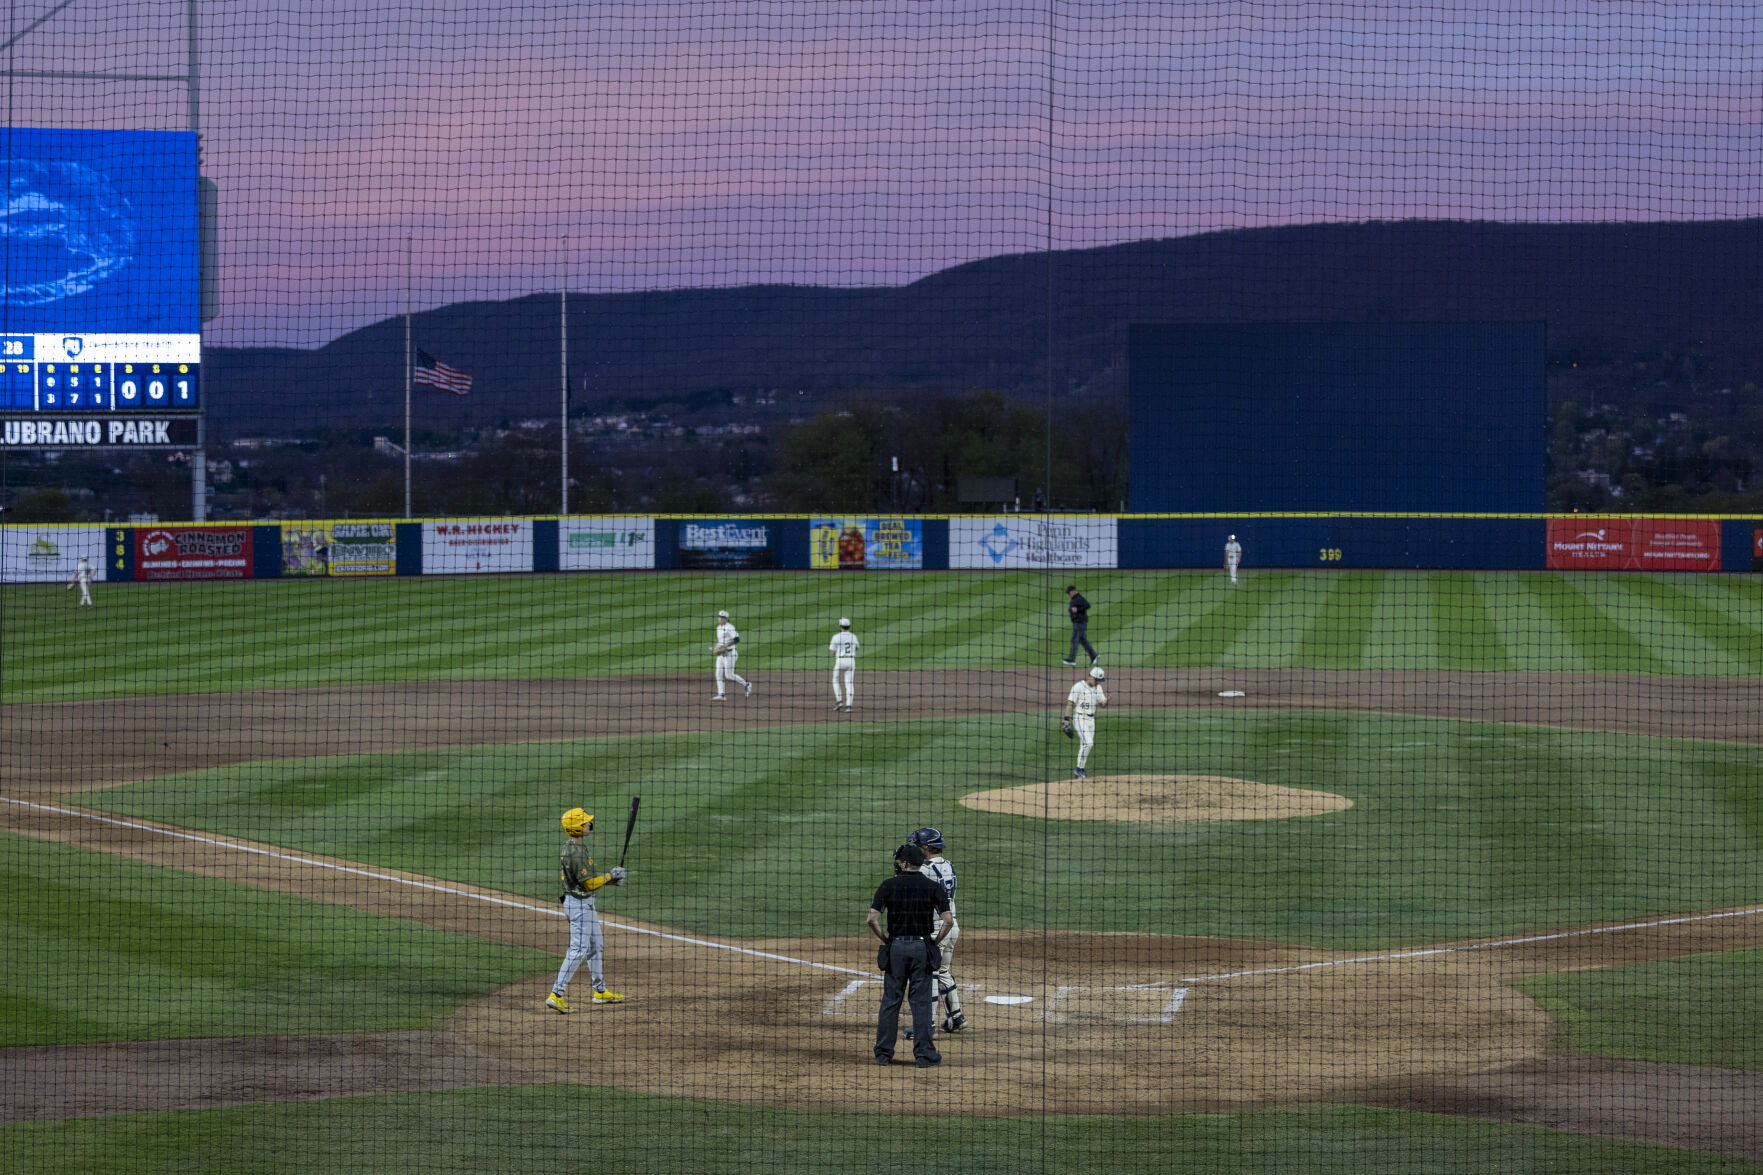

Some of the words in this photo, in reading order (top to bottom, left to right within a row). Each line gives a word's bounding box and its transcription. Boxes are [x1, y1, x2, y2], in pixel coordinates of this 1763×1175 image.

[121, 380, 136, 399] 0
[149, 380, 164, 399] 0
[177, 380, 188, 399] 1
[70, 393, 79, 404] 7
[0, 421, 102, 445] UBRANO
[108, 420, 171, 444] PARK
[436, 524, 465, 536] W.R.
[467, 524, 519, 535] HICKEY
[874, 532, 910, 540] BREWED
[1037, 524, 1071, 537] Penn
[174, 531, 246, 545] CINNAMON
[1019, 536, 1090, 553] Highlands
[178, 543, 242, 556] ROASTED
[884, 542, 900, 550] TEA
[1026, 552, 1082, 562] Healthcare
